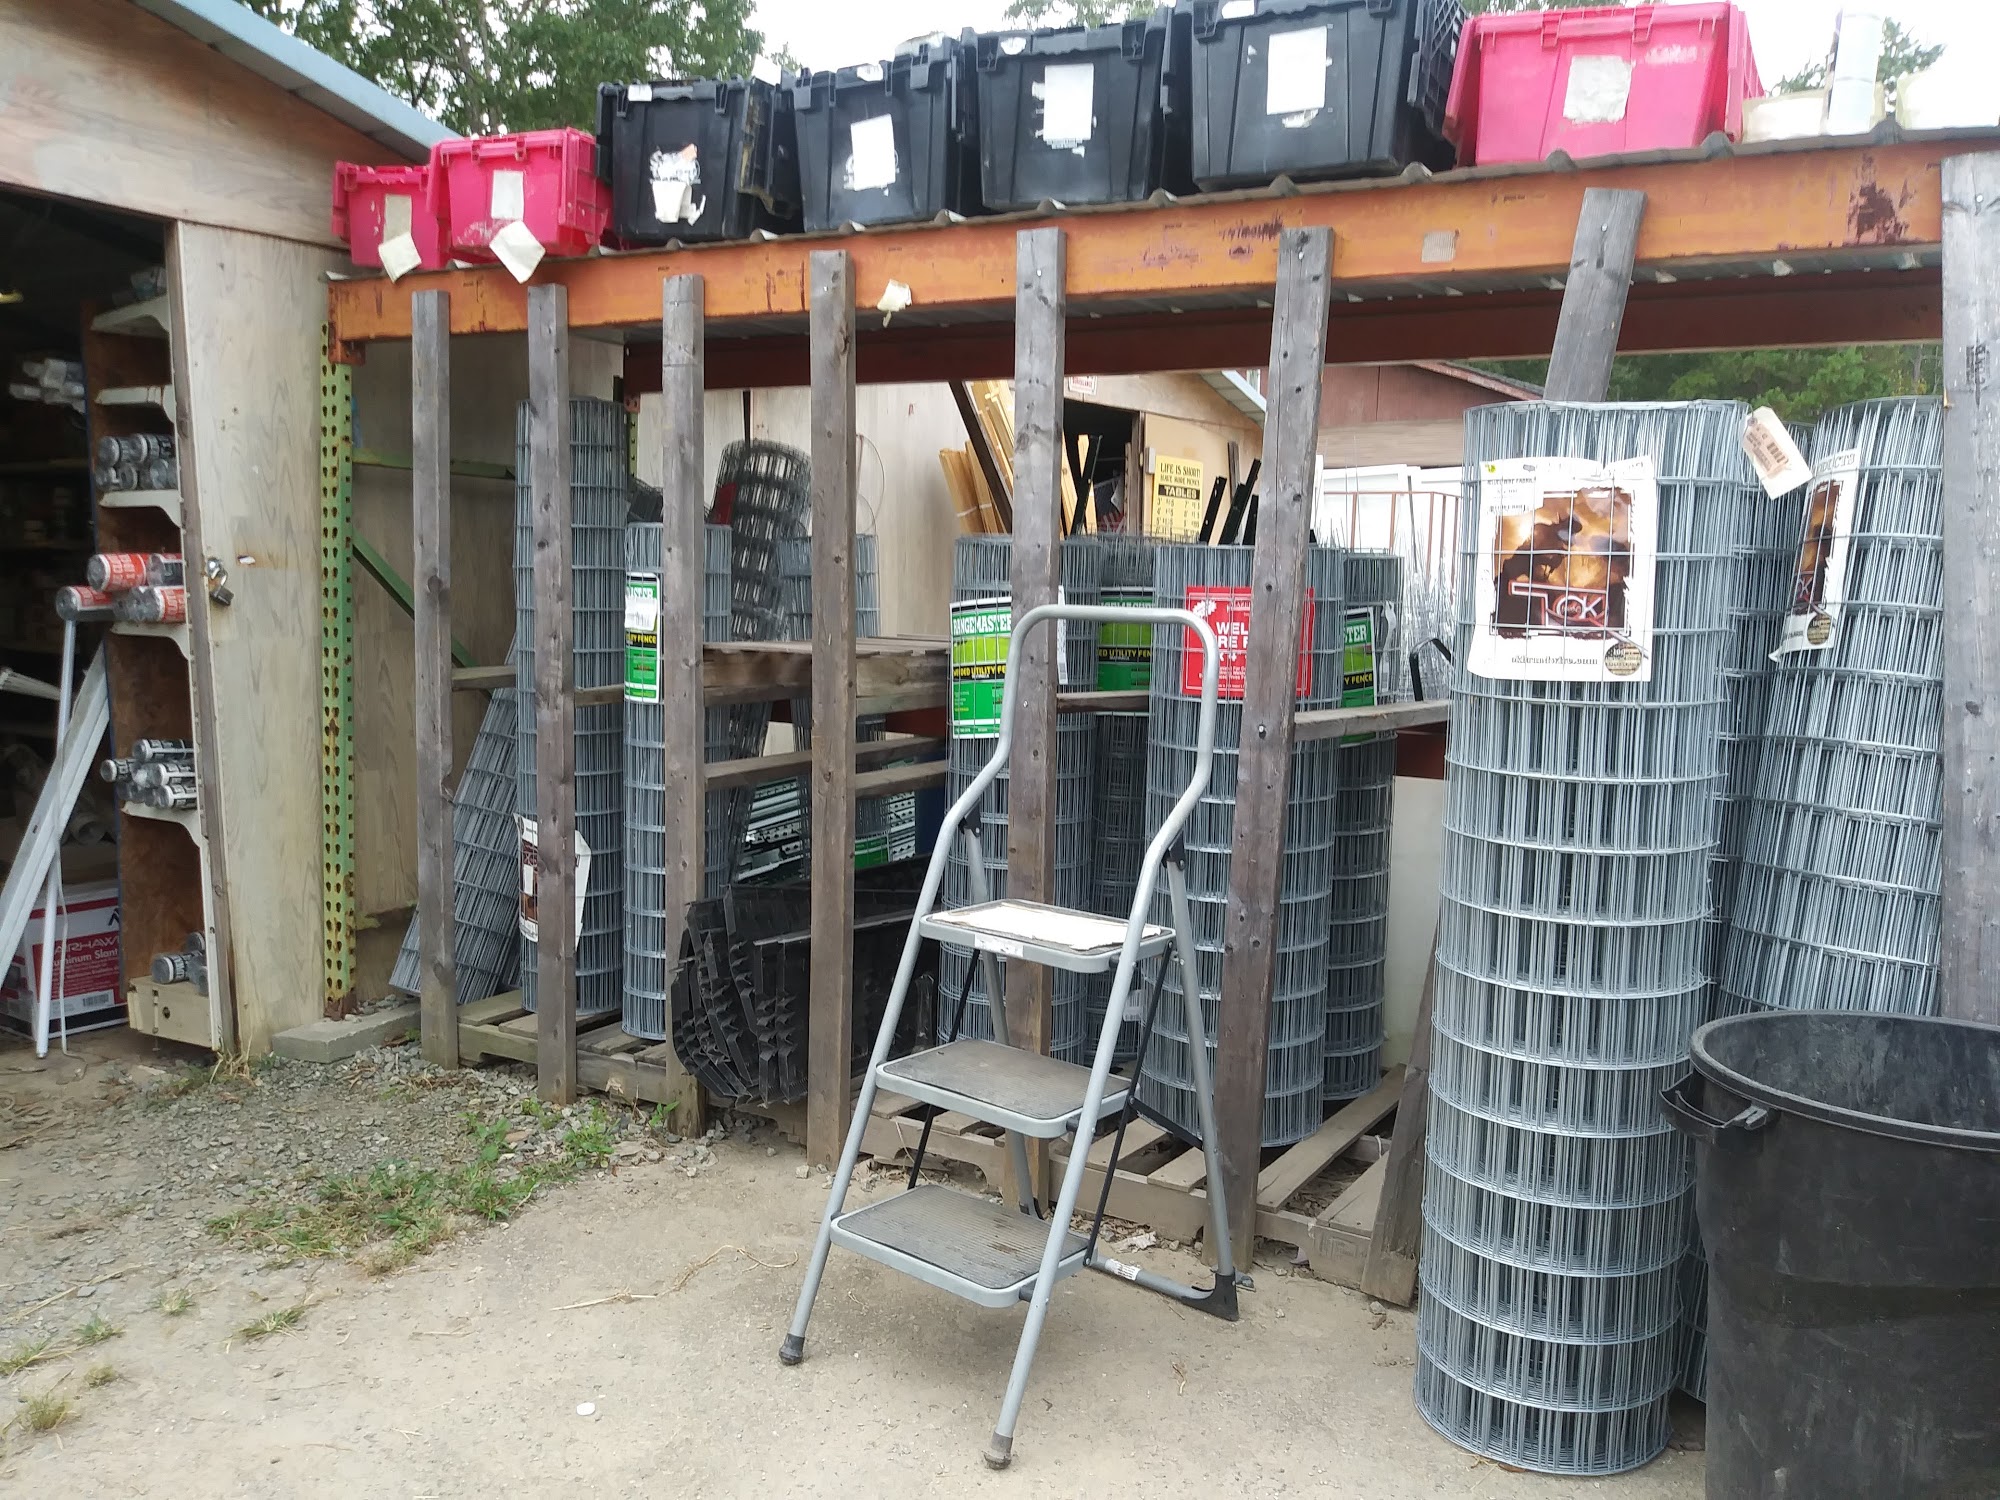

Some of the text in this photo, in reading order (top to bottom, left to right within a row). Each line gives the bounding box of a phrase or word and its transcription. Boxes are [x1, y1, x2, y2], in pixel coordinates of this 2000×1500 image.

[1160, 463, 1173, 474] LIFE
[1175, 465, 1181, 475] IS
[1164, 485, 1196, 499] TABLES
[1109, 648, 1137, 657] UTILITY
[971, 664, 995, 677] UTILITY
[1351, 672, 1373, 684] FENCE
[94, 948, 118, 960] Slant
